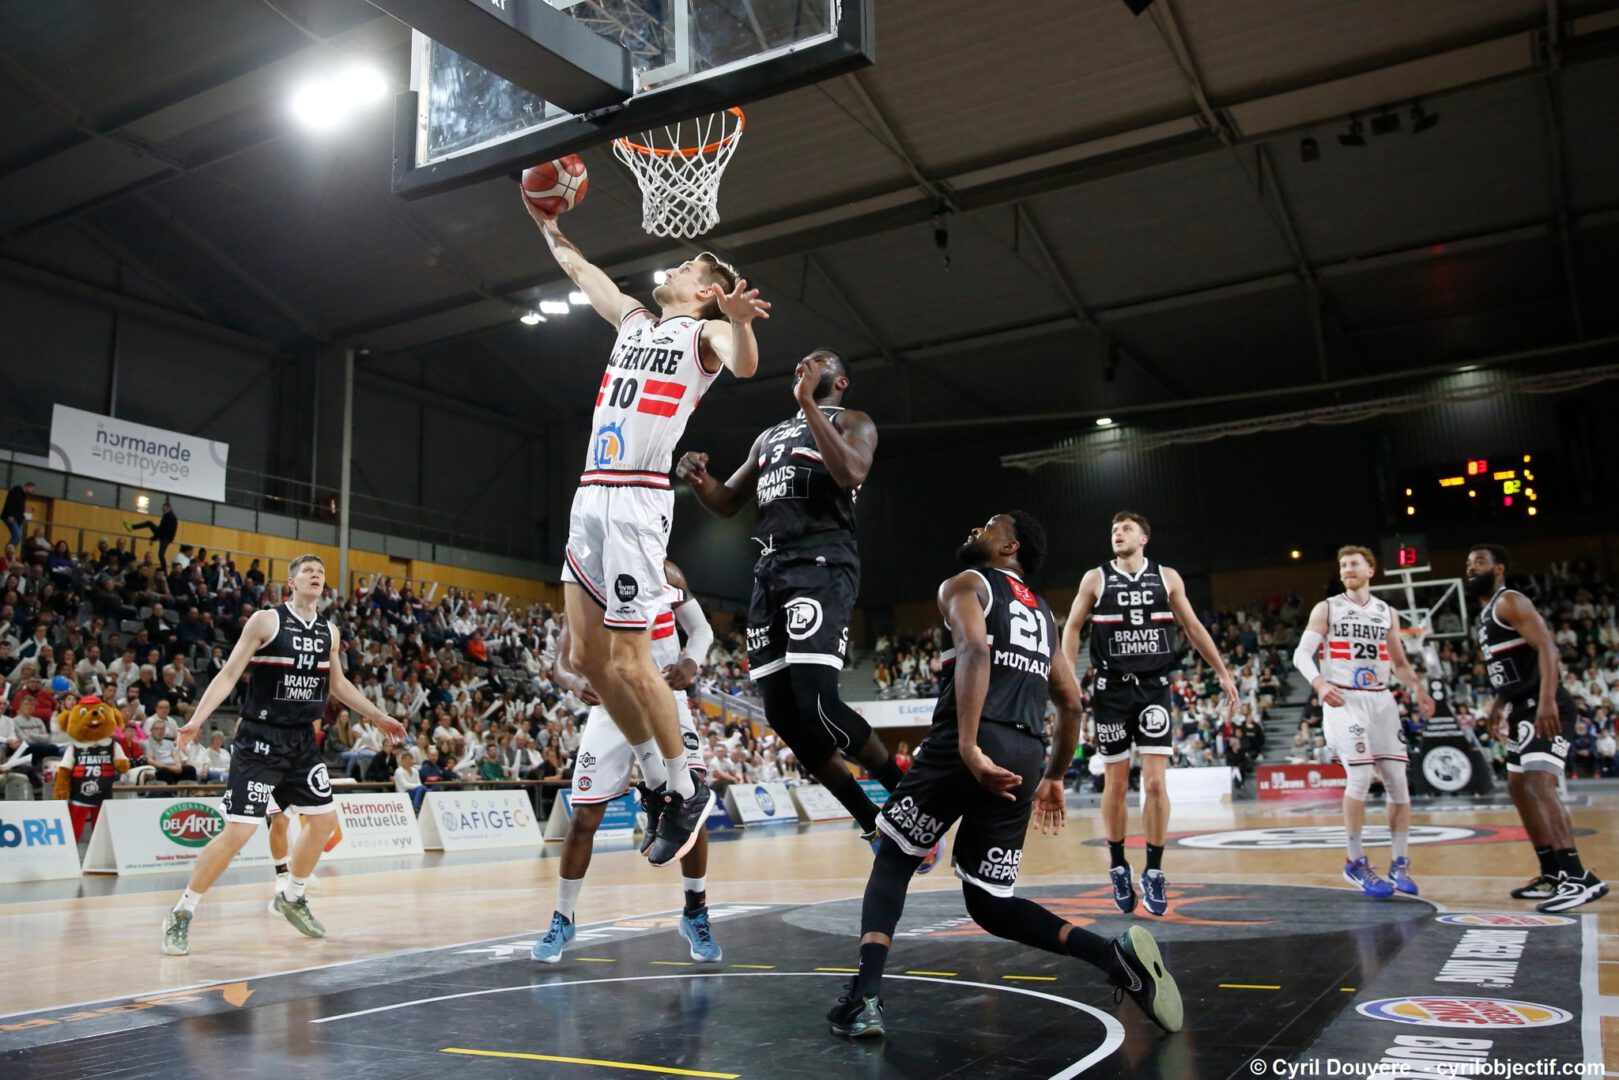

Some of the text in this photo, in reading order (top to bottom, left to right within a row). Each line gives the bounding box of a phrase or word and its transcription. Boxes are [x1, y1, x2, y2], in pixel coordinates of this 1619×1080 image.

[619, 346, 684, 375] HAVRE
[608, 377, 638, 409] 10
[769, 424, 807, 444] CBC
[97, 430, 191, 462] normande
[771, 443, 785, 464] 3
[102, 448, 190, 480] nettoyage
[757, 465, 796, 492] BRAVIS
[1400, 548, 1416, 566] 13
[1117, 590, 1155, 606] CBC
[1130, 608, 1144, 625] 5
[1009, 599, 1050, 658] 21
[1114, 628, 1160, 642] BRAVIS
[1333, 624, 1349, 637] LE
[292, 635, 325, 653] CBC
[1121, 641, 1158, 654] IMMO
[1353, 642, 1378, 660] 29
[296, 653, 315, 670] 14
[284, 674, 320, 688] BRAVIS
[1098, 729, 1127, 743] CLUB
[254, 741, 270, 756] 14
[85, 765, 102, 777] 76
[247, 791, 270, 804] CLU
[341, 800, 404, 815] Harmonie
[901, 795, 944, 834] CAEN
[162, 813, 223, 840] DEL ARTE
[345, 814, 408, 828] mutuelle
[460, 809, 529, 831] AFIGEC
[887, 802, 936, 844] REPRO
[392, 836, 413, 849] vyv
[987, 846, 1023, 865] CAE
